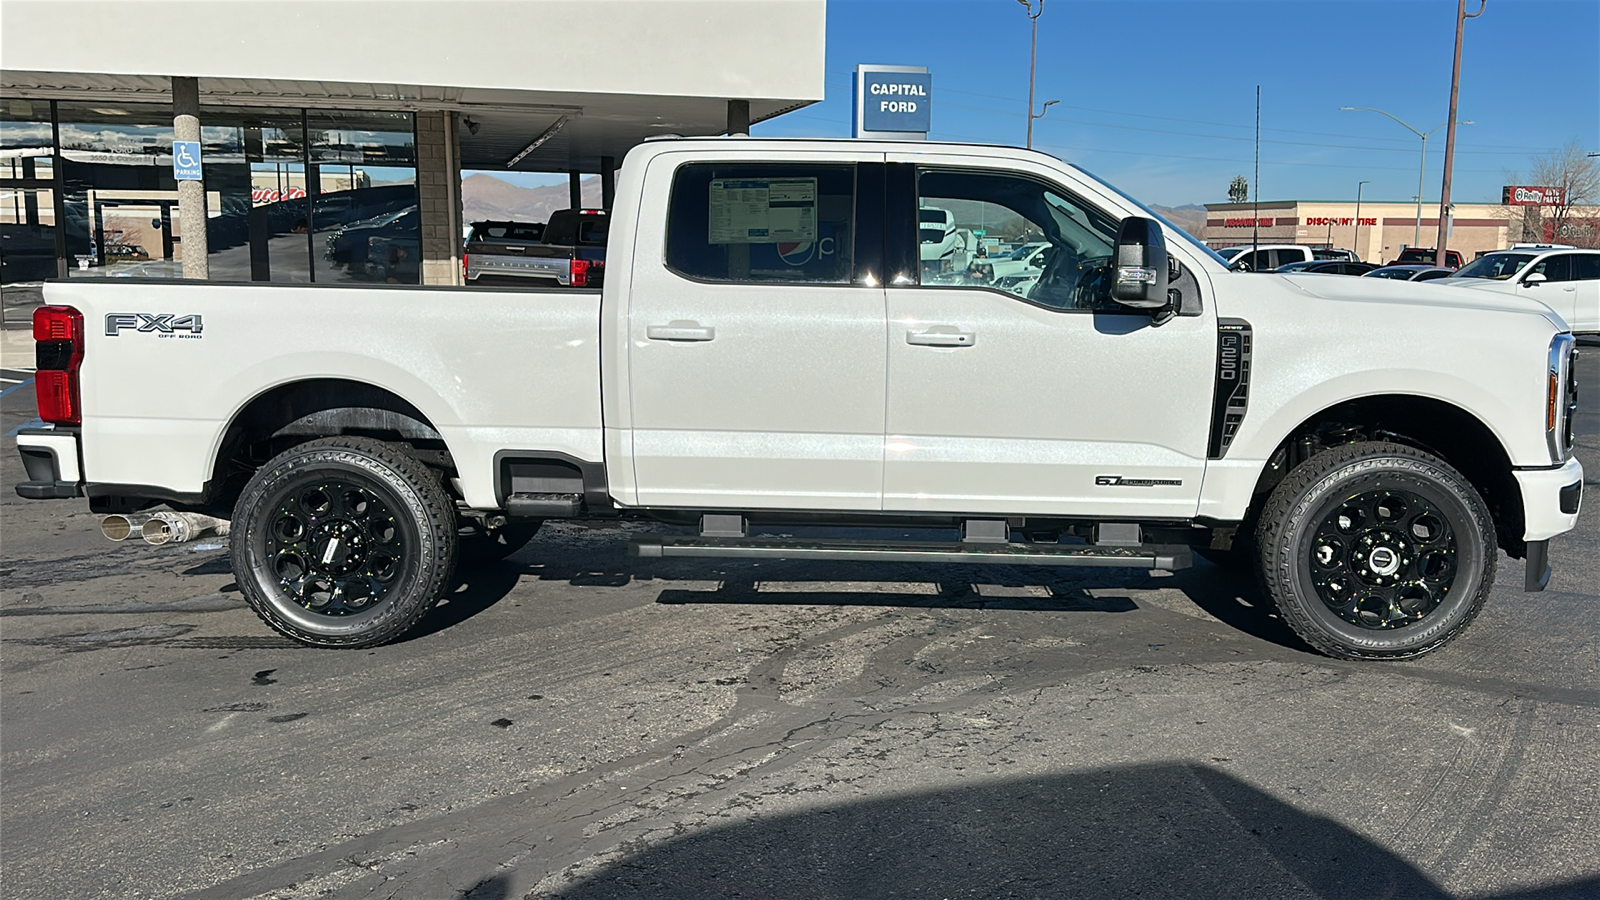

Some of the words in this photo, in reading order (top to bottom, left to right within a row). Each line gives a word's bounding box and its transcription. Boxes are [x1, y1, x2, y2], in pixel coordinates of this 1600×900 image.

[870, 83, 926, 96] CAPITAL
[880, 101, 917, 113] FORD
[176, 168, 200, 176] PARKING
[1514, 188, 1543, 204] O'Reilly
[1545, 188, 1560, 196] AUTO
[1543, 196, 1560, 204] PARTS
[1357, 217, 1378, 226] TIRE
[484, 261, 549, 269] PLATINUM
[105, 313, 204, 337] FX4
[1220, 336, 1238, 381] F250
[1095, 475, 1122, 487] 6.7
